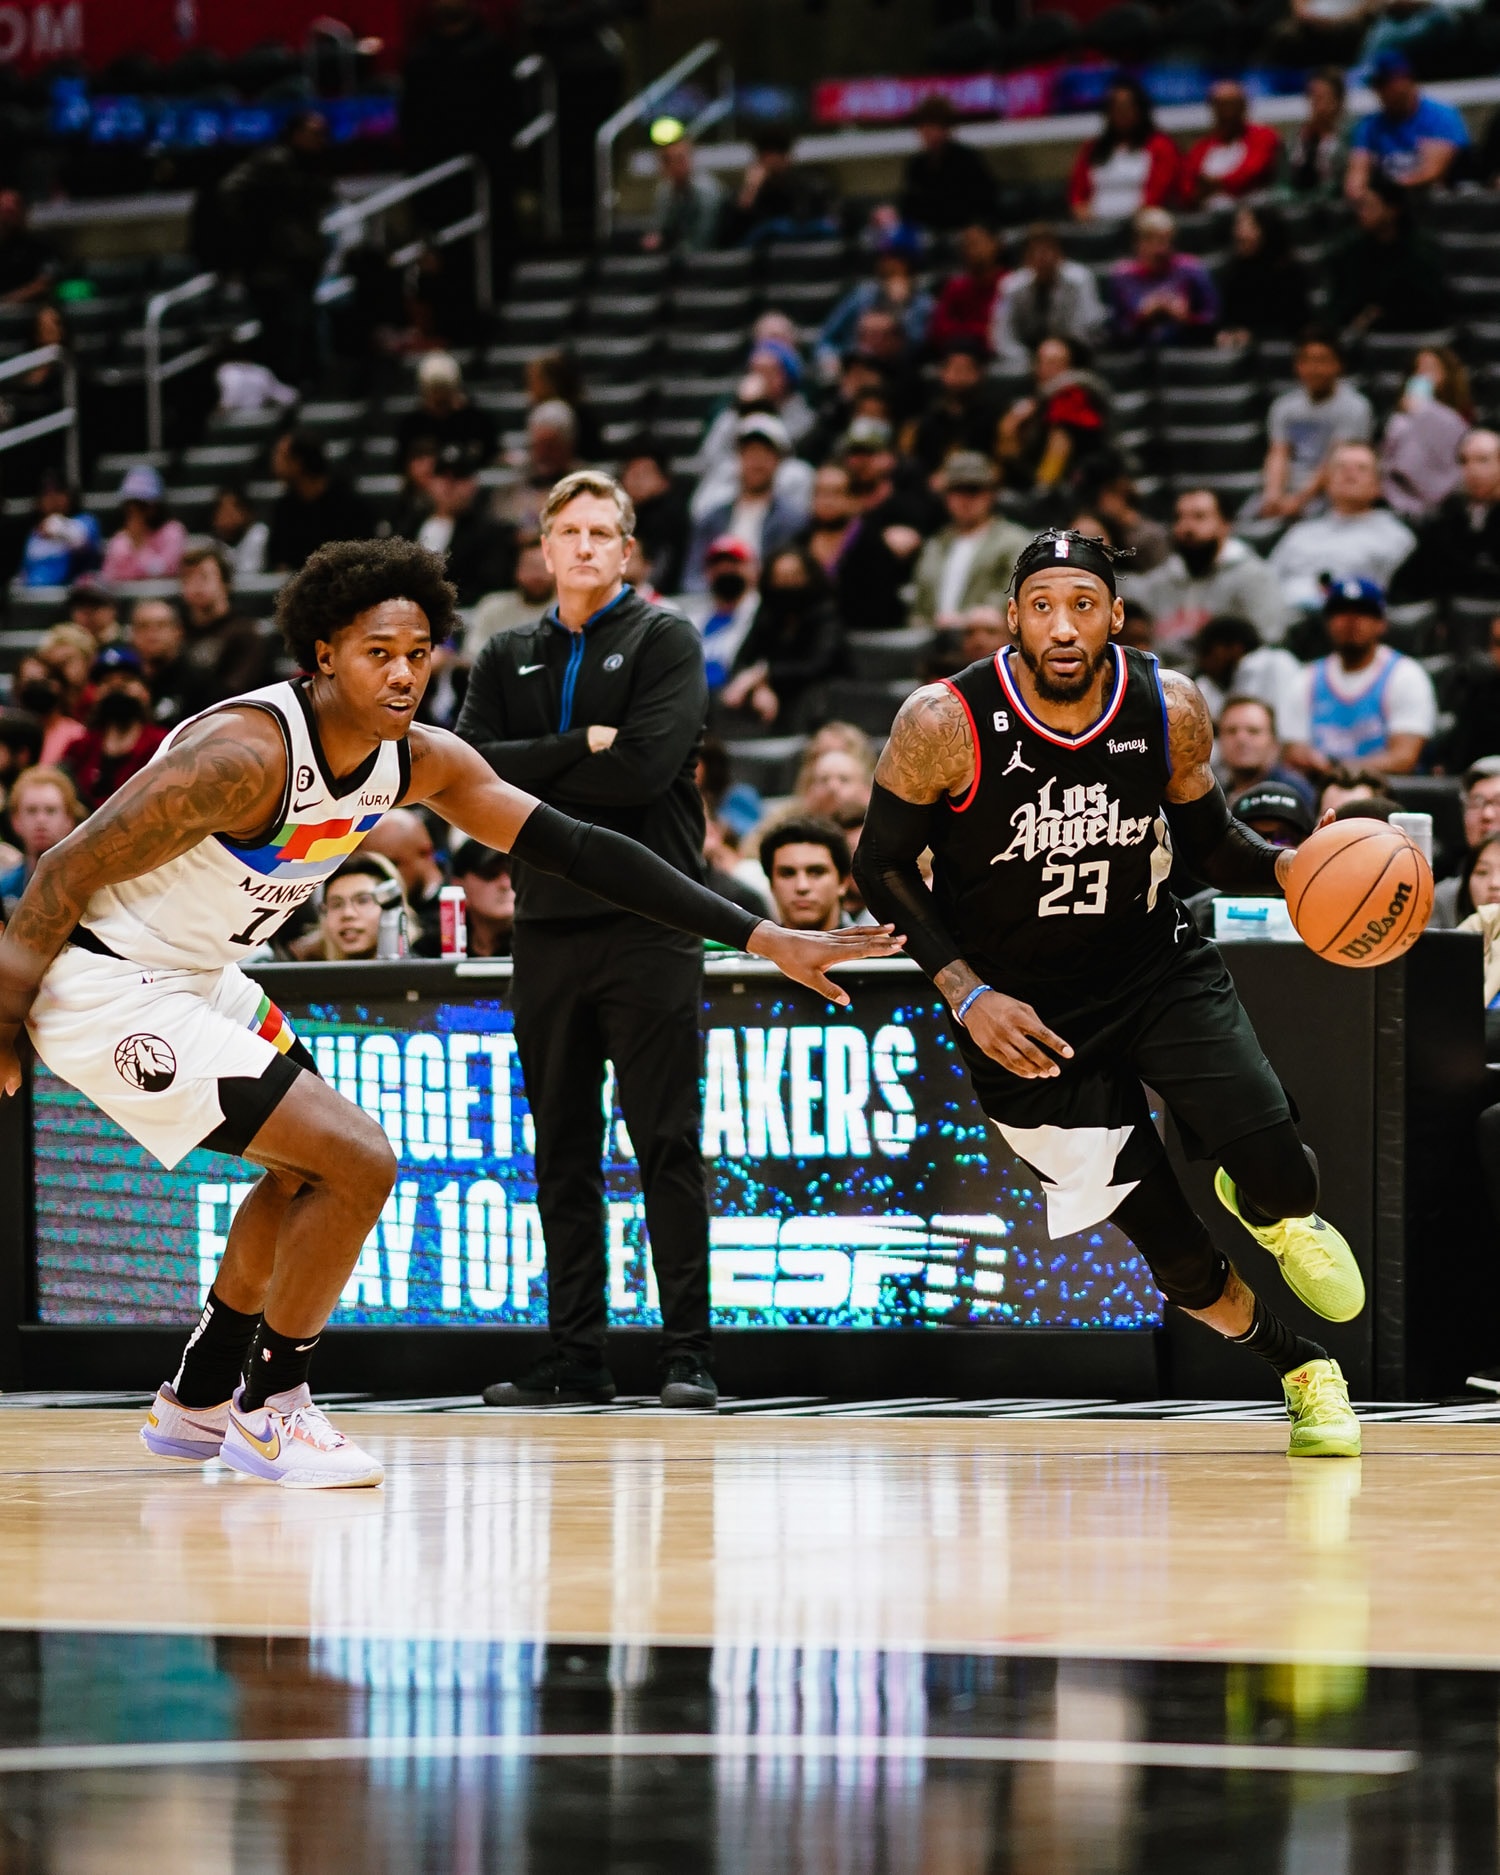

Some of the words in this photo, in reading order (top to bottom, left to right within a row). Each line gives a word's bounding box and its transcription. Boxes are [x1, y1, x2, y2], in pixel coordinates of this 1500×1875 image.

[993, 710, 1009, 732] 6
[1106, 738, 1148, 754] honey
[298, 766, 313, 791] 6
[1036, 776, 1109, 823] Los
[990, 799, 1152, 867] Angeles
[1038, 860, 1110, 918] 23
[228, 903, 296, 947] 1
[1338, 882, 1413, 959] Wilson
[701, 1025, 918, 1157] AKERS
